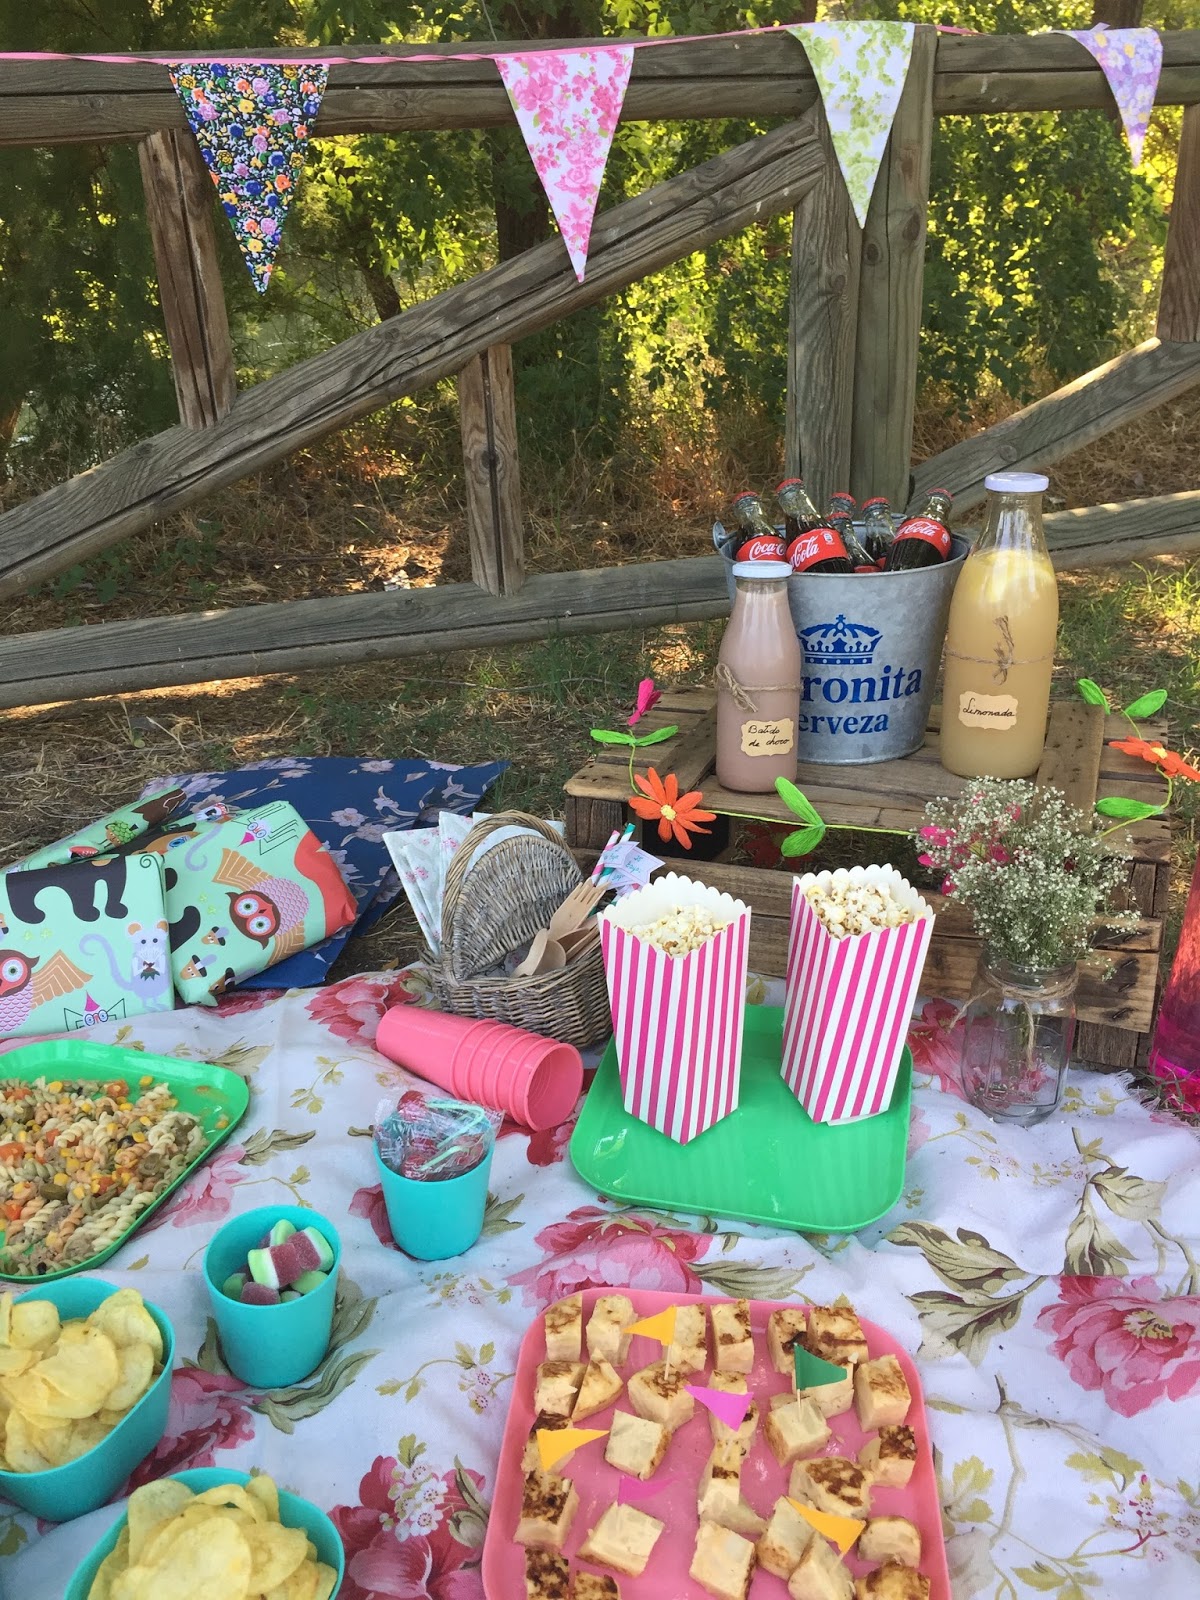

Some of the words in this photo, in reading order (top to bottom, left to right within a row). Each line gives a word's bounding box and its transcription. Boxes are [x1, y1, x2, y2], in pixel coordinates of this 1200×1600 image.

[749, 541, 787, 560] Coca-C
[801, 665, 922, 703] ronita
[963, 697, 1015, 717] Limonada
[748, 725, 780, 734] Batido
[799, 713, 889, 734] erveza
[748, 739, 760, 747] de
